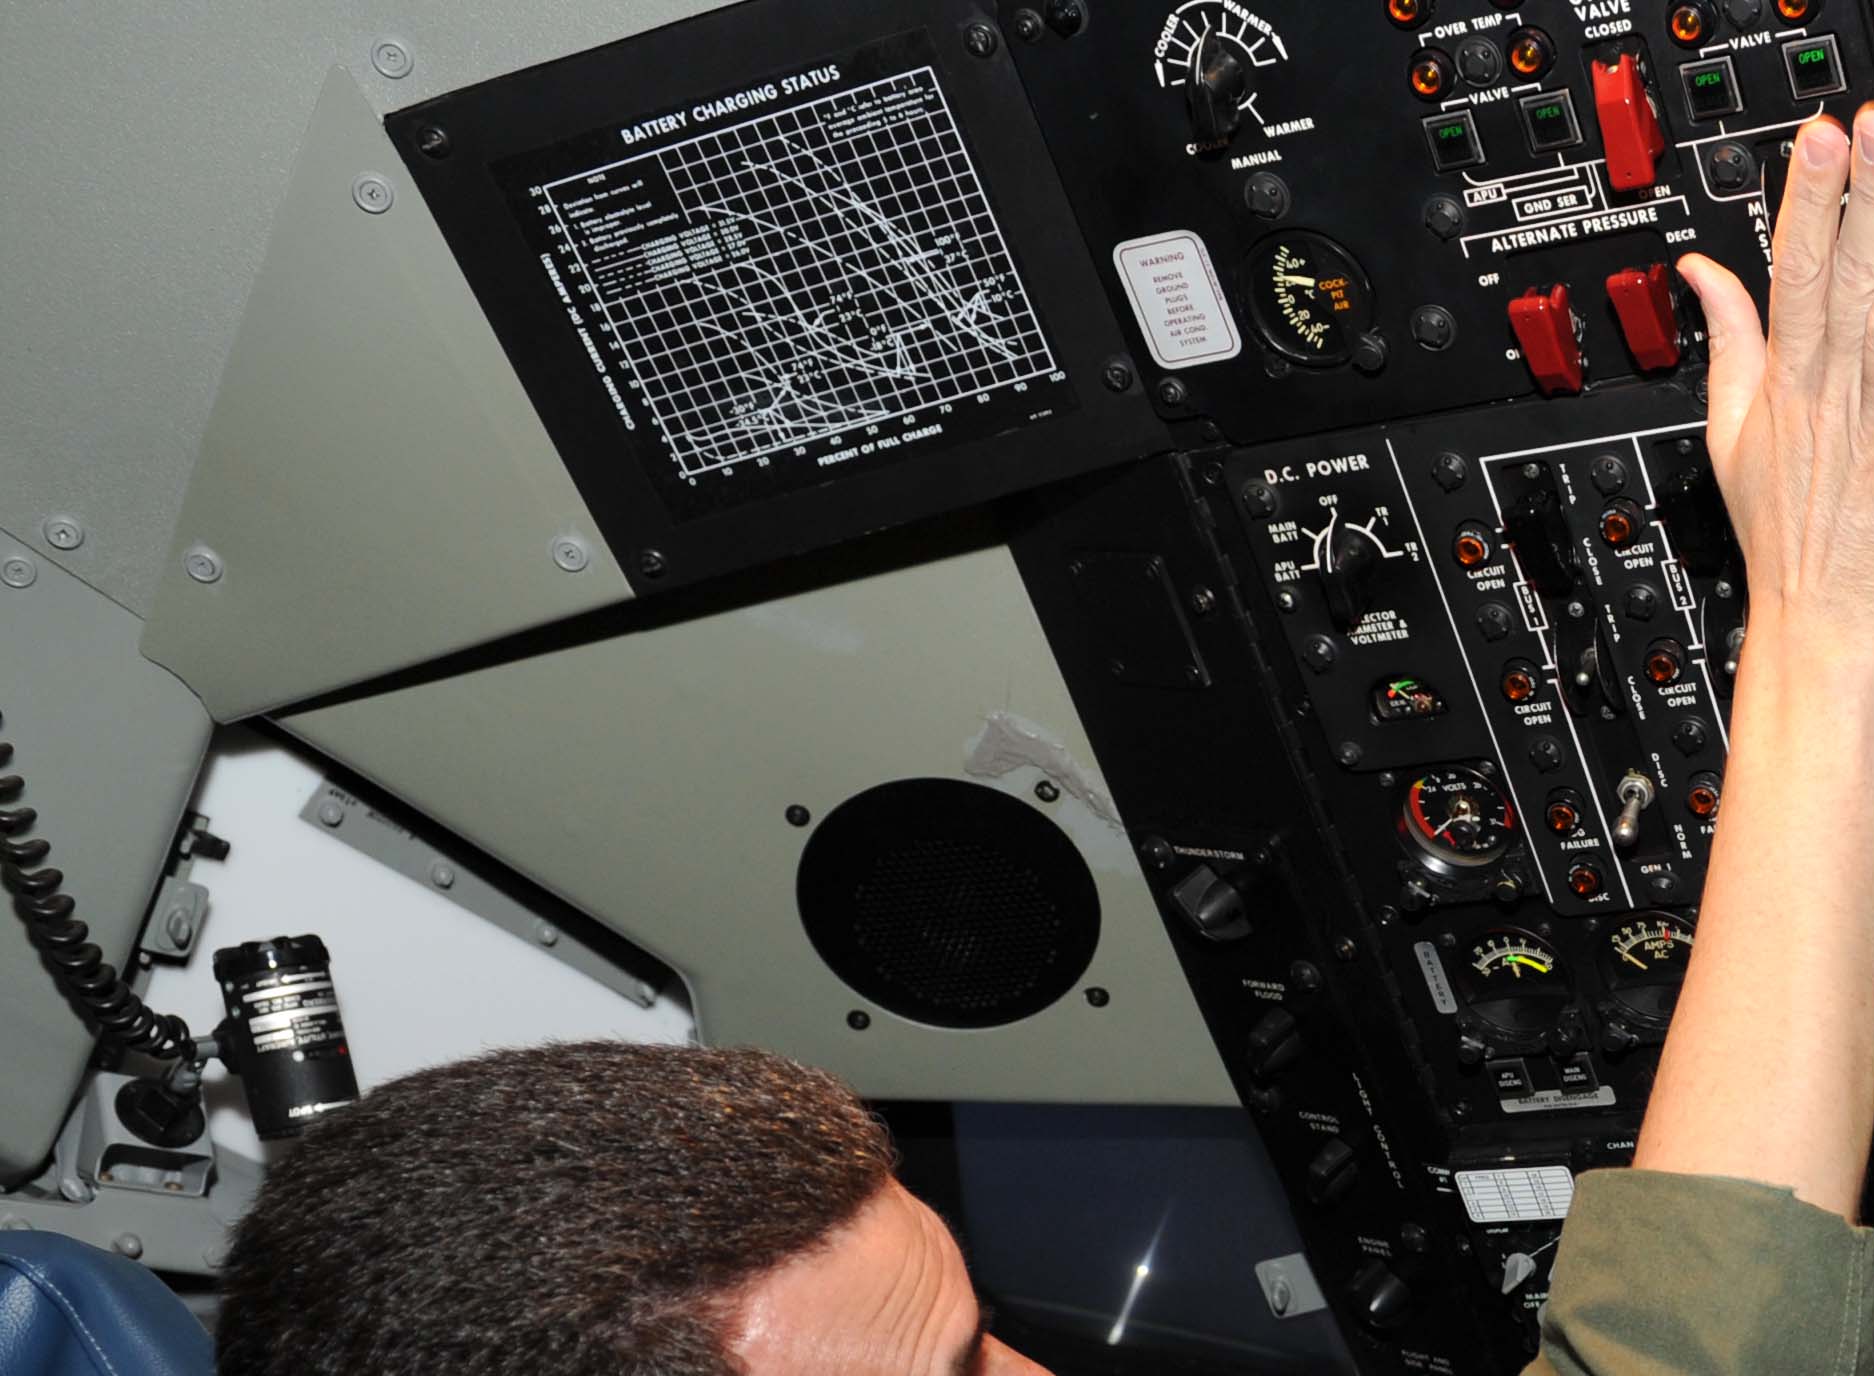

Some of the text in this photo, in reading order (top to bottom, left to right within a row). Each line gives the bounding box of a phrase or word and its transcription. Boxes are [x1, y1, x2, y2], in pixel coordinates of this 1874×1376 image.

[1573, 0, 1631, 22] VALVE
[1218, 0, 1273, 41] WARMER
[1434, 12, 1503, 39] OVER TEMP
[1154, 13, 1184, 58] COOLER
[1728, 30, 1772, 51] VALVE
[620, 64, 841, 145] BATTERY CHARGING STATUS
[1468, 86, 1510, 105] VALVE
[1262, 117, 1315, 138] WARMER
[1230, 149, 1283, 170] MANUAL
[1473, 189, 1497, 202] APU
[1523, 193, 1578, 215] GND SER
[1491, 206, 1659, 253] ALTERNATE PRESSURE
[1665, 227, 1697, 244] DECR
[1138, 251, 1185, 268] WARNING
[1152, 271, 1184, 284] REMOVE
[1318, 277, 1348, 291] COCK-
[1155, 281, 1189, 296] GROUND
[1330, 289, 1345, 300] PIT
[566, 305, 584, 325] (DC
[1163, 312, 1206, 328] OPERATING
[576, 327, 607, 374] CURRENT
[1178, 335, 1207, 348] SYSTEM
[1048, 370, 1067, 383] 100
[1013, 381, 1028, 393] 90
[602, 375, 636, 431] CHARGING
[976, 392, 991, 404] 80
[938, 403, 953, 415] 70
[816, 423, 943, 467] PERCENT OF FULL CHARGE
[1263, 453, 1370, 485] D.C. POWER
[1558, 463, 1577, 505] TRIP
[1267, 521, 1297, 534] MAIN
[1271, 530, 1299, 544] BATT
[1274, 561, 1295, 572] APU
[1582, 537, 1603, 586] CLOSE
[1274, 570, 1300, 583] BATT
[1350, 628, 1409, 646] VOLTMETER
[1514, 701, 1552, 715] CIRCUIT
[1650, 752, 1669, 788] DISC
[1560, 837, 1600, 851] FAILURE
[1673, 823, 1693, 859] NORM
[1172, 845, 1245, 861] THUNDERSTORM
